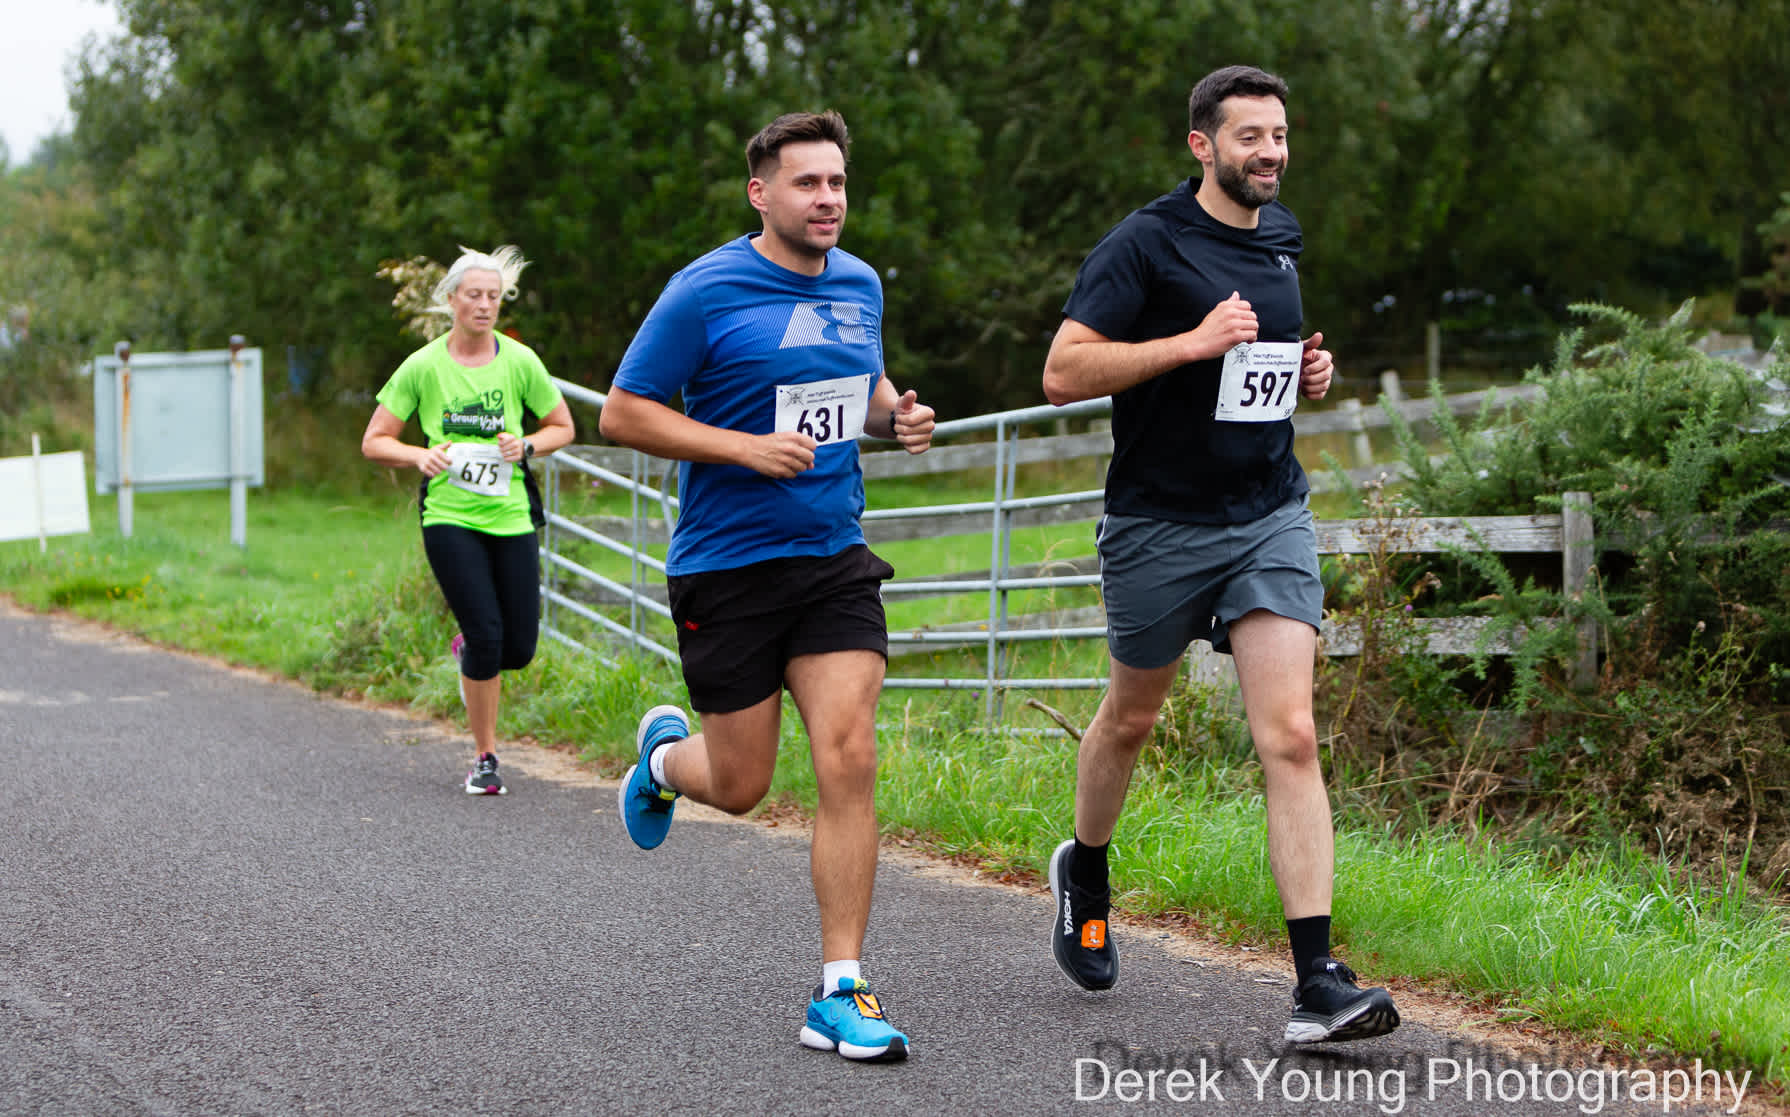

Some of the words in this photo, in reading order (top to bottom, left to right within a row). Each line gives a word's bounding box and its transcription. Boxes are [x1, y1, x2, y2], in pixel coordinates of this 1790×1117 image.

[1239, 371, 1294, 407] 597
[450, 413, 478, 425] Group
[797, 404, 844, 442] 631
[460, 462, 499, 486] 675
[1063, 890, 1075, 936] HOKA
